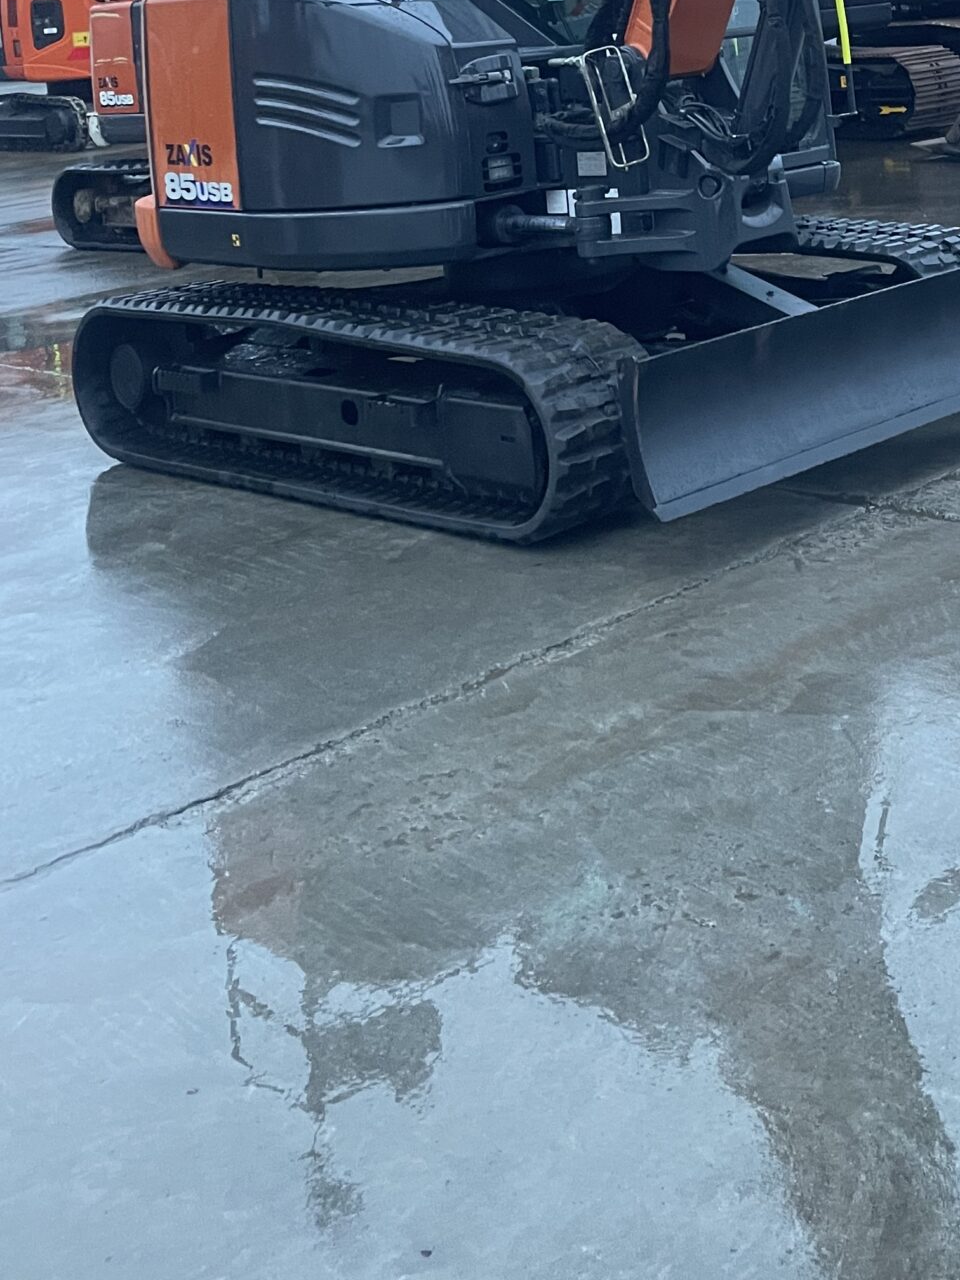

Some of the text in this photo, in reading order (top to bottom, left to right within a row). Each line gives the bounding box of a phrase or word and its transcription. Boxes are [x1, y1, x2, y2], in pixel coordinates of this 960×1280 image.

[99, 90, 135, 107] 85USB
[165, 138, 213, 167] ZAXIS
[164, 172, 234, 203] 85USB
